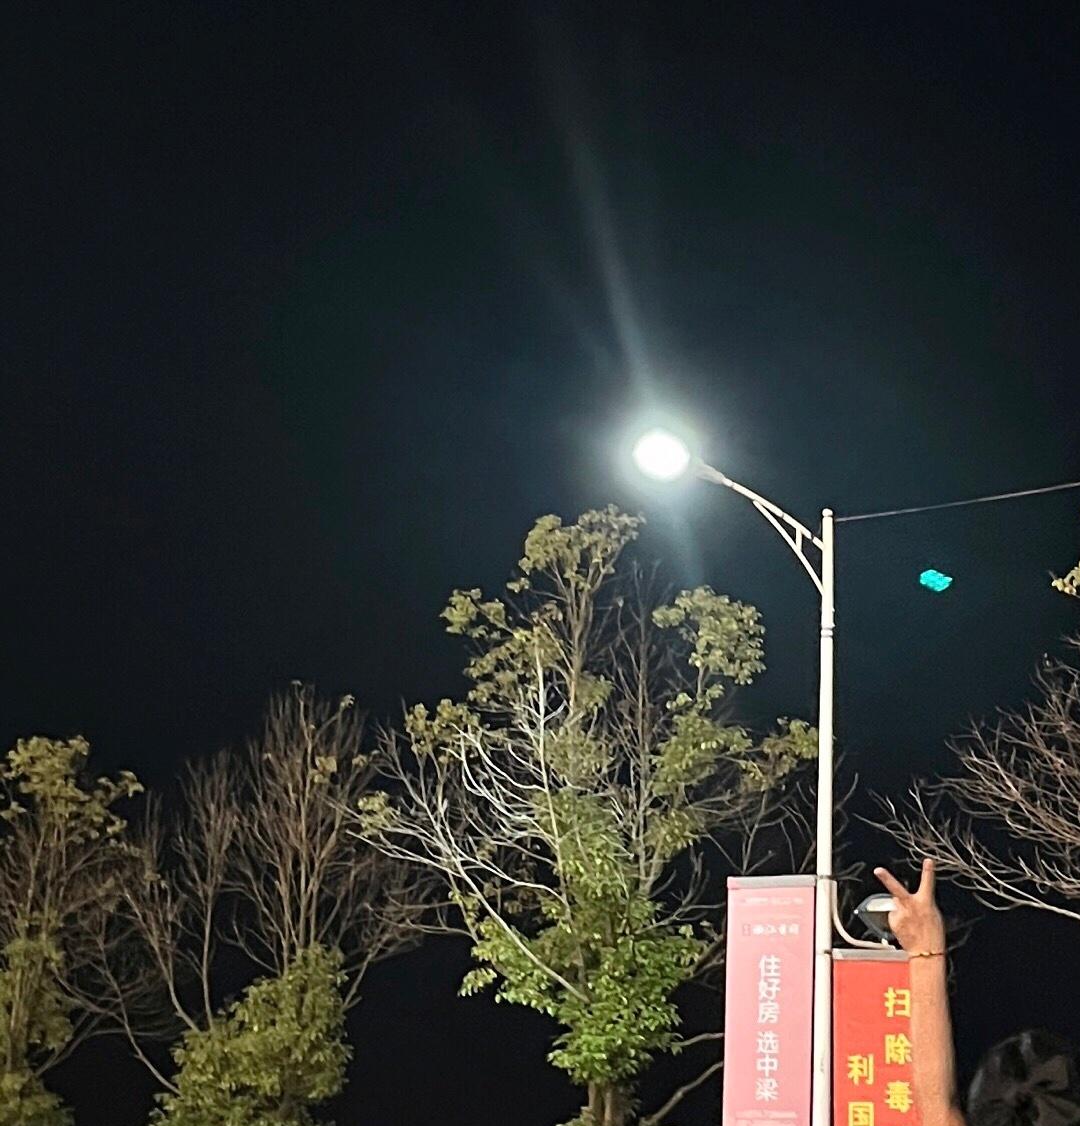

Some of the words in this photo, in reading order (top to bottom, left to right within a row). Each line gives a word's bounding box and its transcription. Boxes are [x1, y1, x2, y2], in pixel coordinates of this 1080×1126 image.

[758, 954, 781, 1023] 住好房
[754, 1030, 780, 1101] 选中梁
